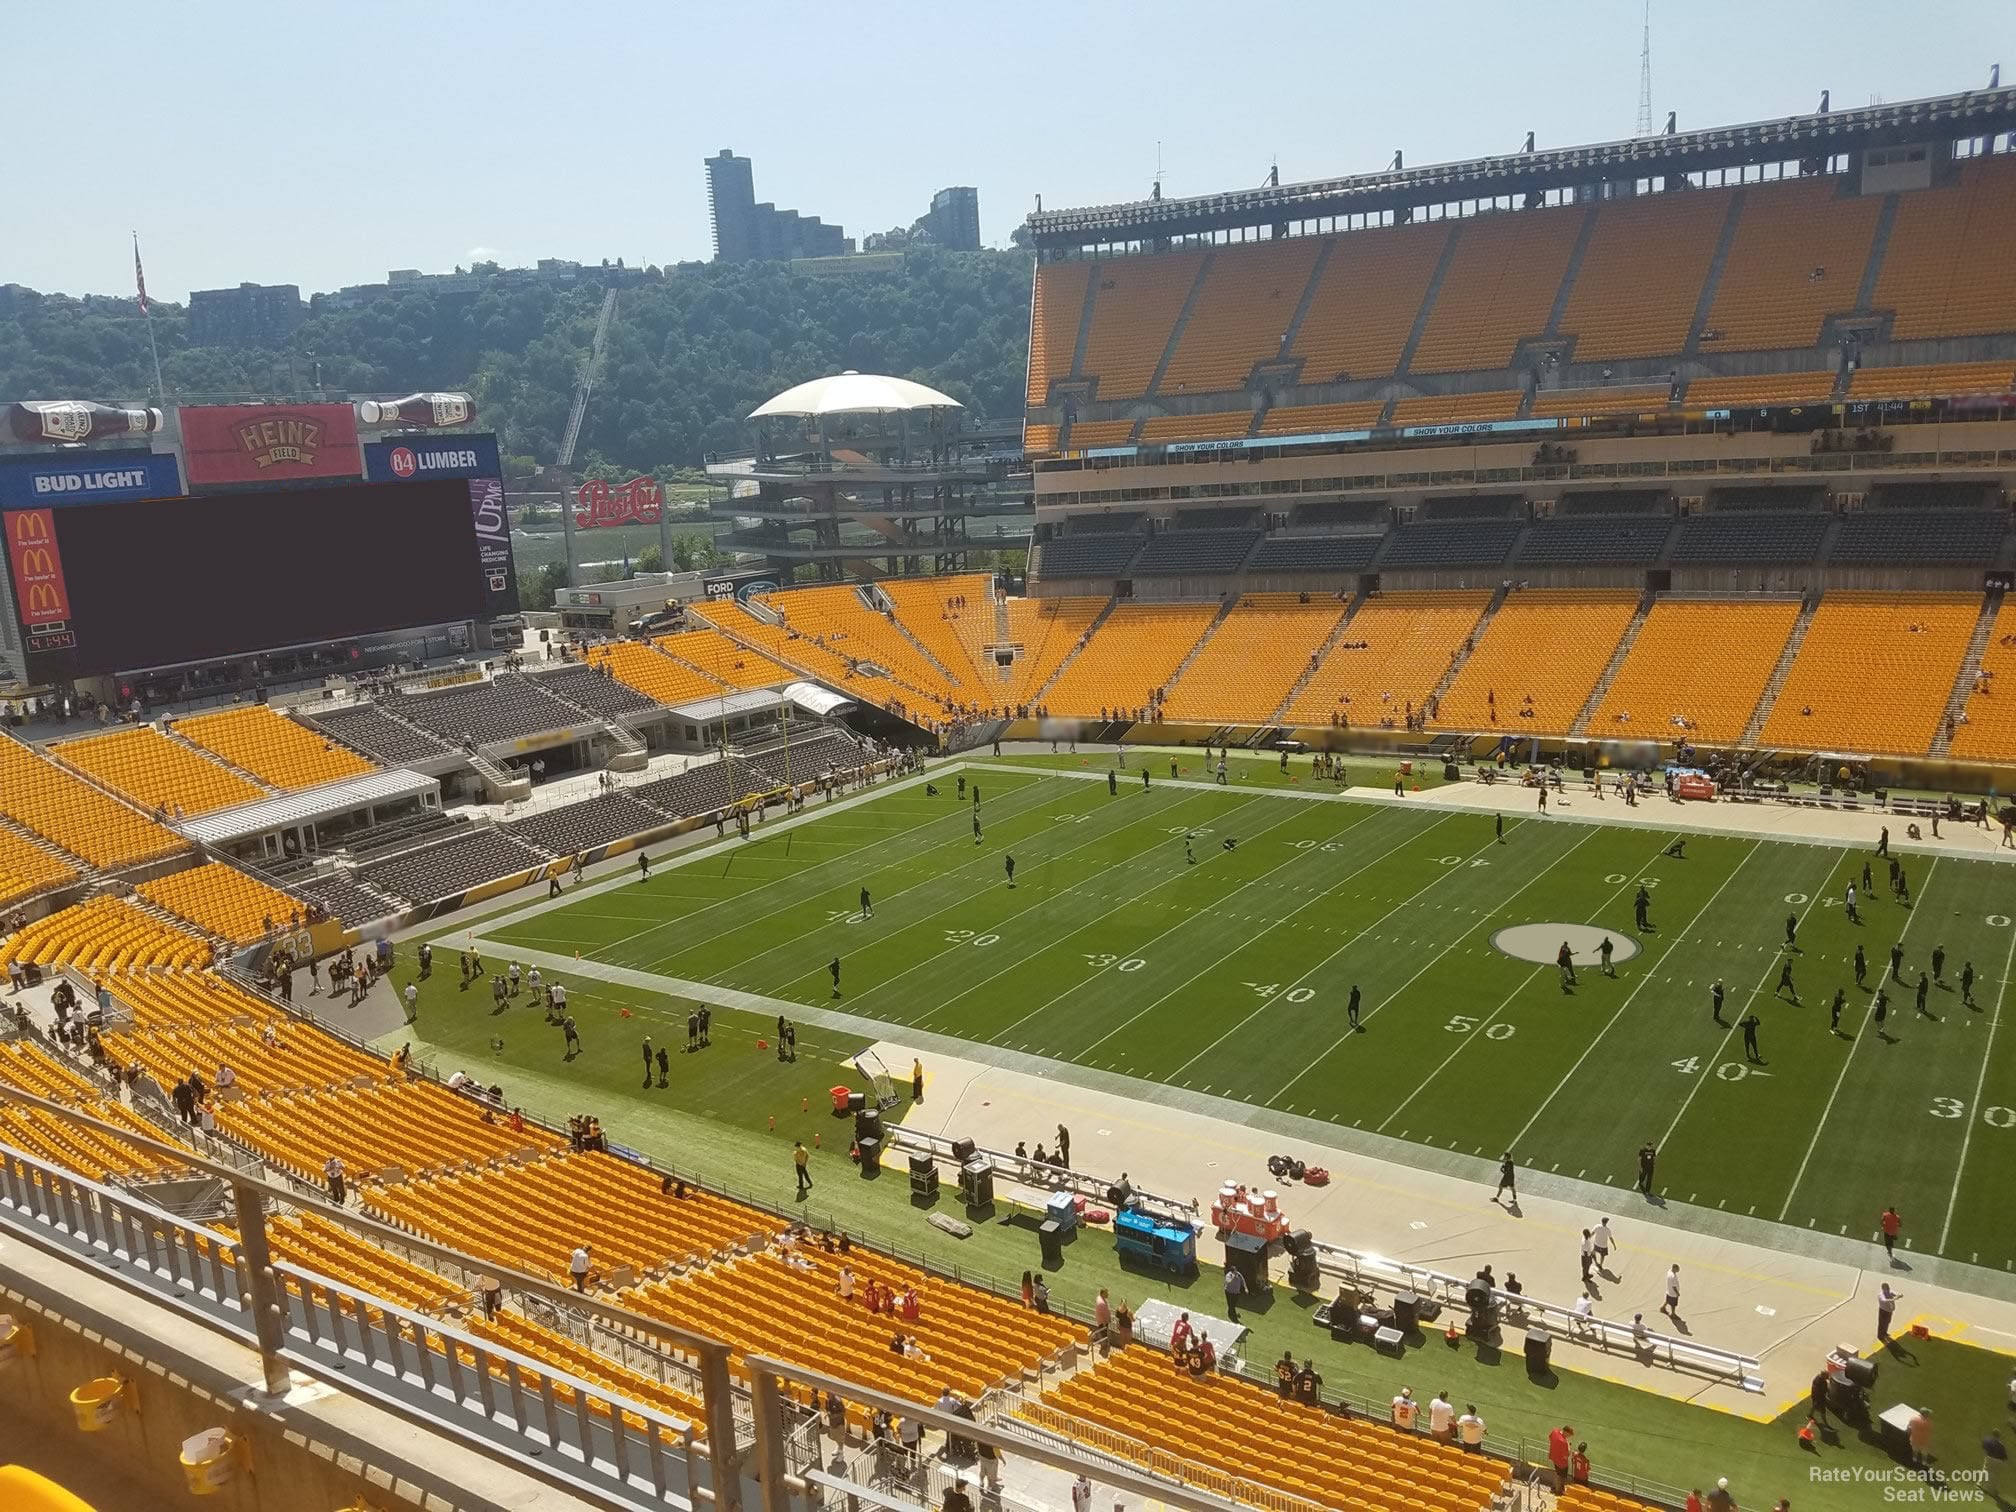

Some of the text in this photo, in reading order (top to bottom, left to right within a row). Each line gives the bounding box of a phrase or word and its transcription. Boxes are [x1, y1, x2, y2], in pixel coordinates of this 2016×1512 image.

[240, 420, 319, 452] HEINZ
[1414, 424, 1493, 436] SHOW YOUR COLORS
[273, 446, 297, 458] FIELD
[1175, 441, 1244, 452] SHOW YOUR COLORS
[393, 450, 478, 471] 84 LUMBER
[35, 470, 144, 493] BUD LIGHT
[475, 480, 503, 533] UPMC
[707, 582, 734, 595] FORD
[31, 633, 71, 649] 41:44
[364, 640, 411, 653] NEIGHBORHOOD
[427, 678, 442, 689] LIVE
[443, 674, 467, 687] UNITED
[283, 931, 315, 963] 33
[1303, 1379, 1312, 1392] 2
